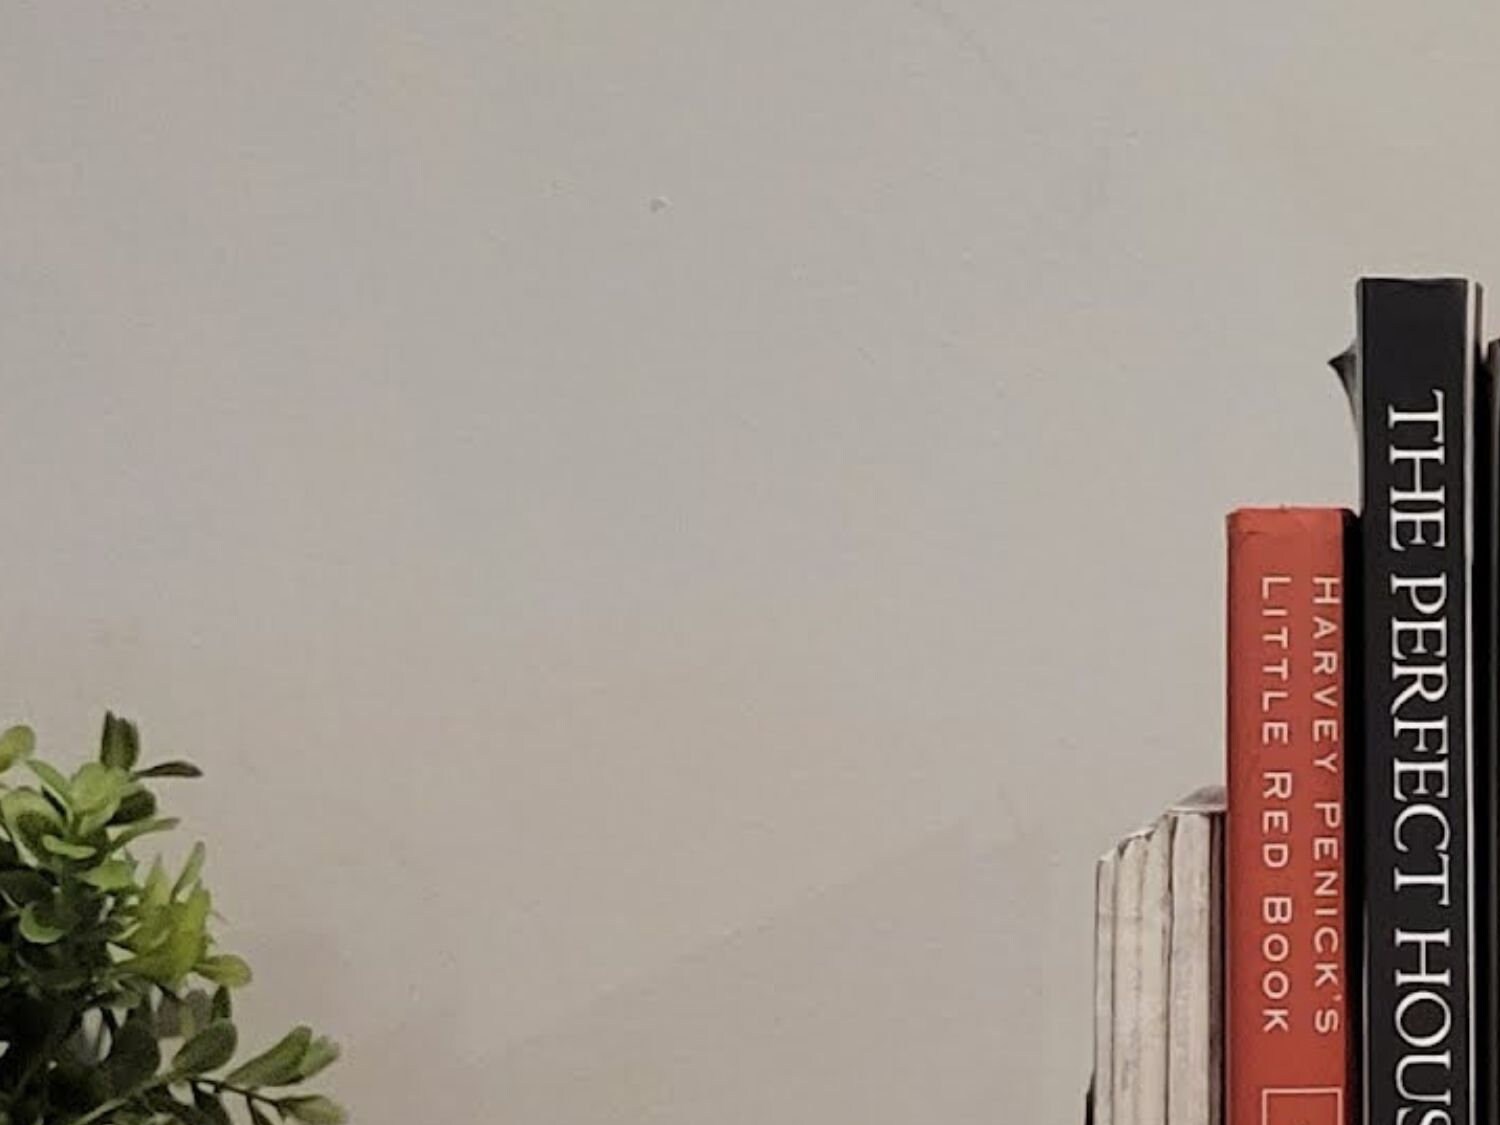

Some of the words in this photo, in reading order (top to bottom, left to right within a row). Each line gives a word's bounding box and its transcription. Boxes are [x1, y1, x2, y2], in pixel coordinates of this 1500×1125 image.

[1388, 389, 1445, 552] THE
[1261, 575, 1292, 745] LITTLE
[1312, 576, 1342, 774] HARVEY
[1390, 573, 1451, 906] PERFECT
[1262, 771, 1292, 869] RED
[1262, 896, 1293, 1034] BOOK
[1312, 801, 1342, 1035] PENICK'S
